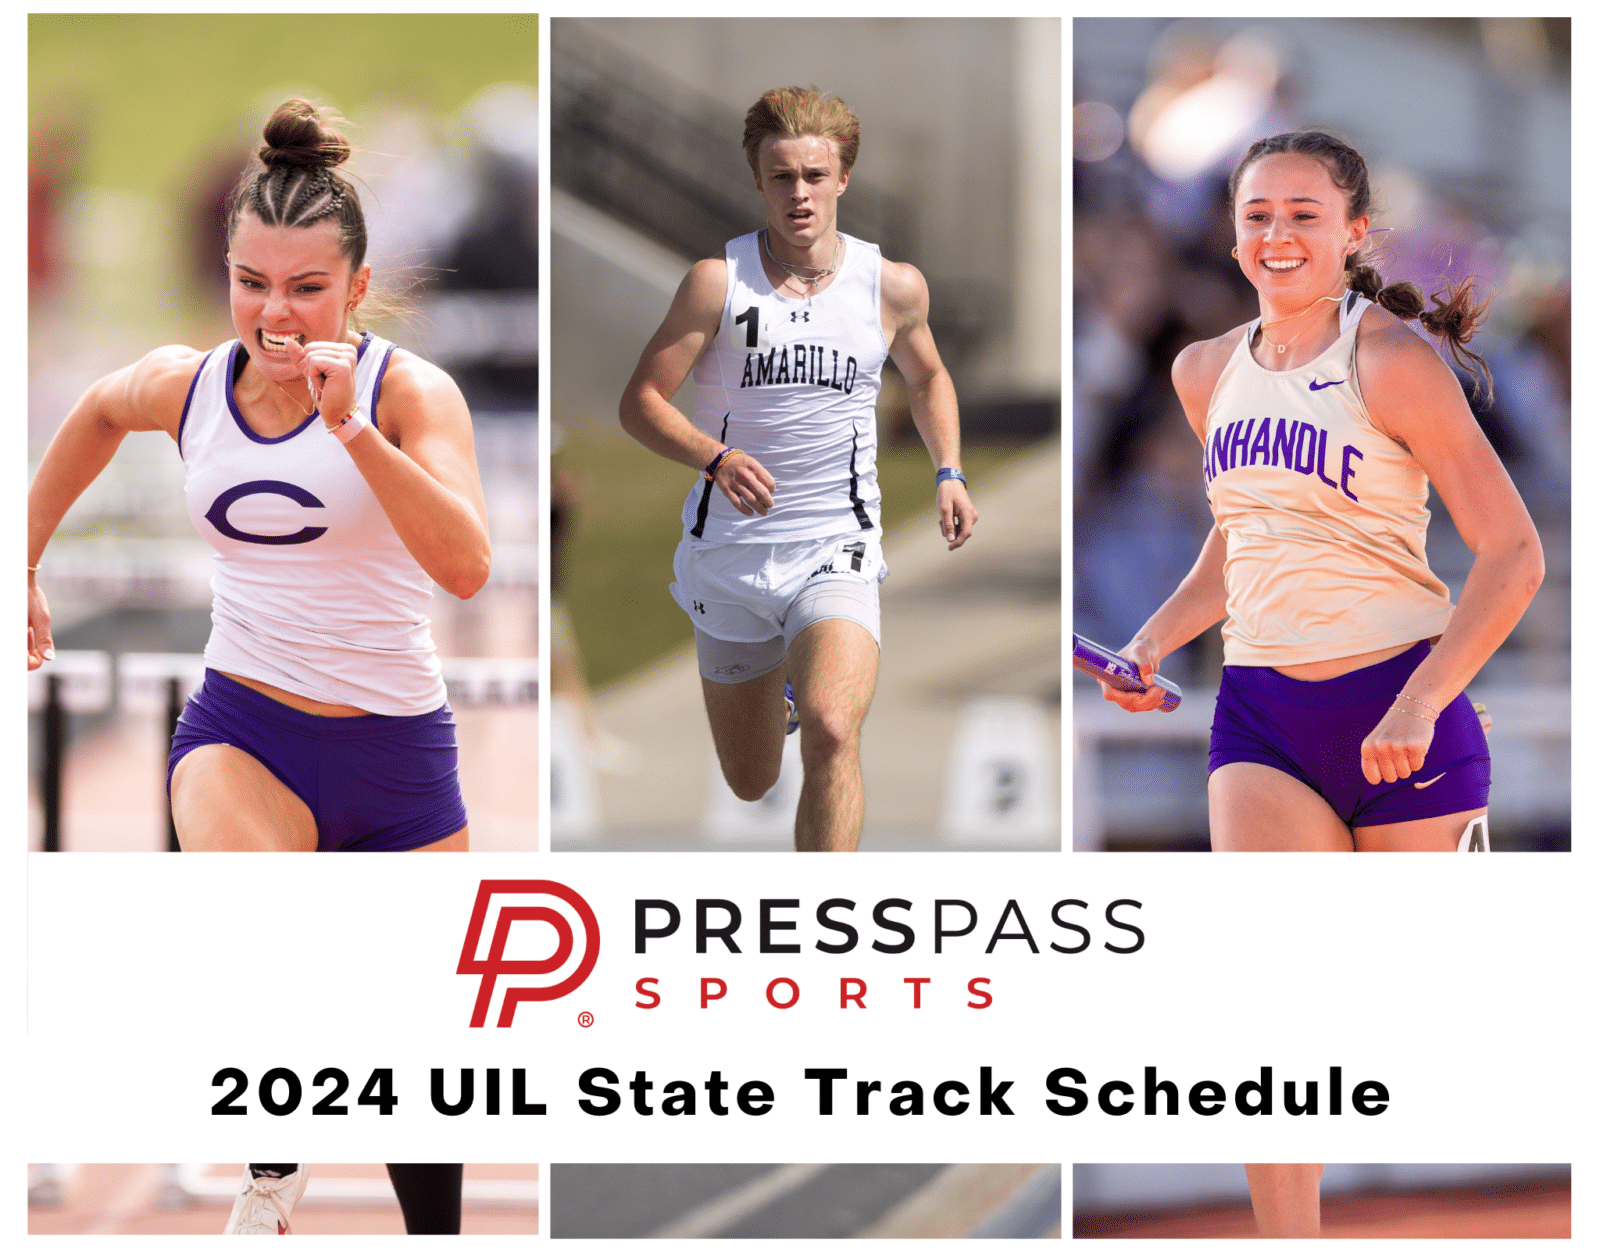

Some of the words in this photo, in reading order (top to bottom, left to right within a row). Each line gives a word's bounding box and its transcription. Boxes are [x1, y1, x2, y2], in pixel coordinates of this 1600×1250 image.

[735, 306, 760, 348] 1
[740, 344, 857, 395] AMARILLO
[1203, 416, 1364, 505] ANHANDLE
[205, 480, 327, 545] C
